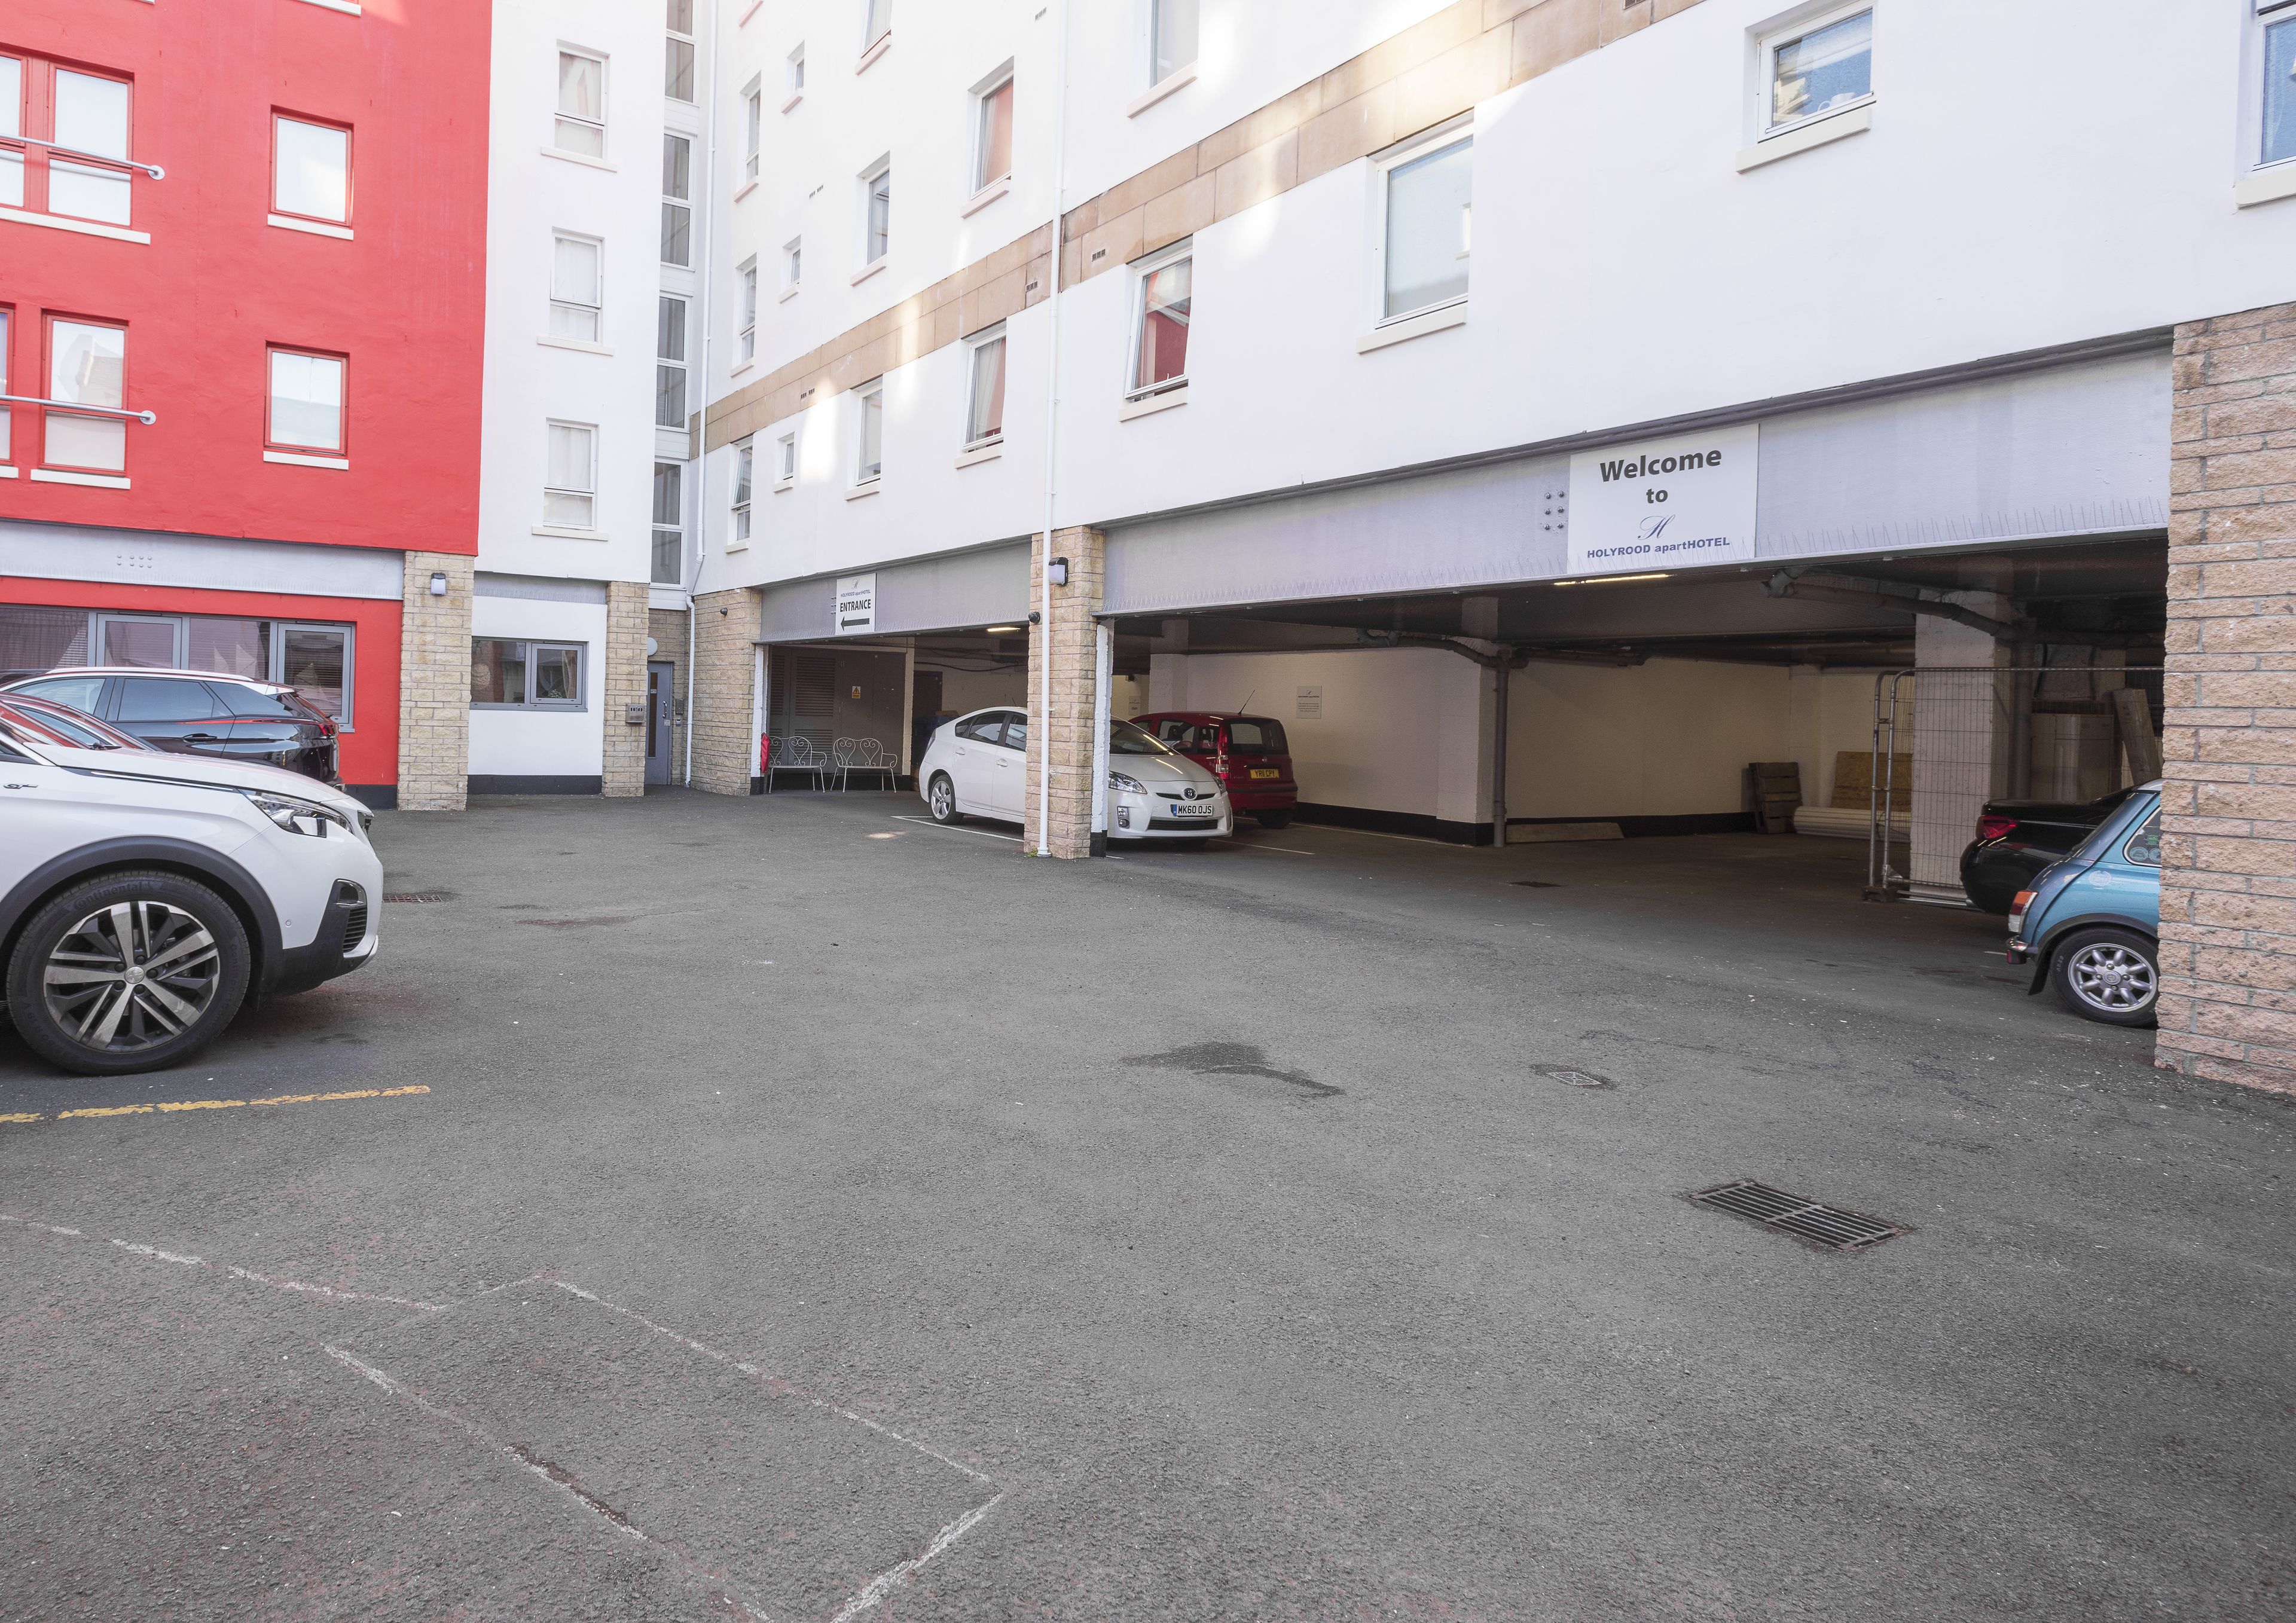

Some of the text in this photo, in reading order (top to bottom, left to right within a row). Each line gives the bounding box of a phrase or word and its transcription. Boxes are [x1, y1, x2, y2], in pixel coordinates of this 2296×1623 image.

[1600, 449, 1722, 482] Welcome
[1646, 488, 1668, 504] to
[1587, 537, 1730, 558] HOLYROOD apartHOTEL
[840, 599, 871, 612] ENTRANCE
[1178, 805, 1212, 814] MK60 OJS
